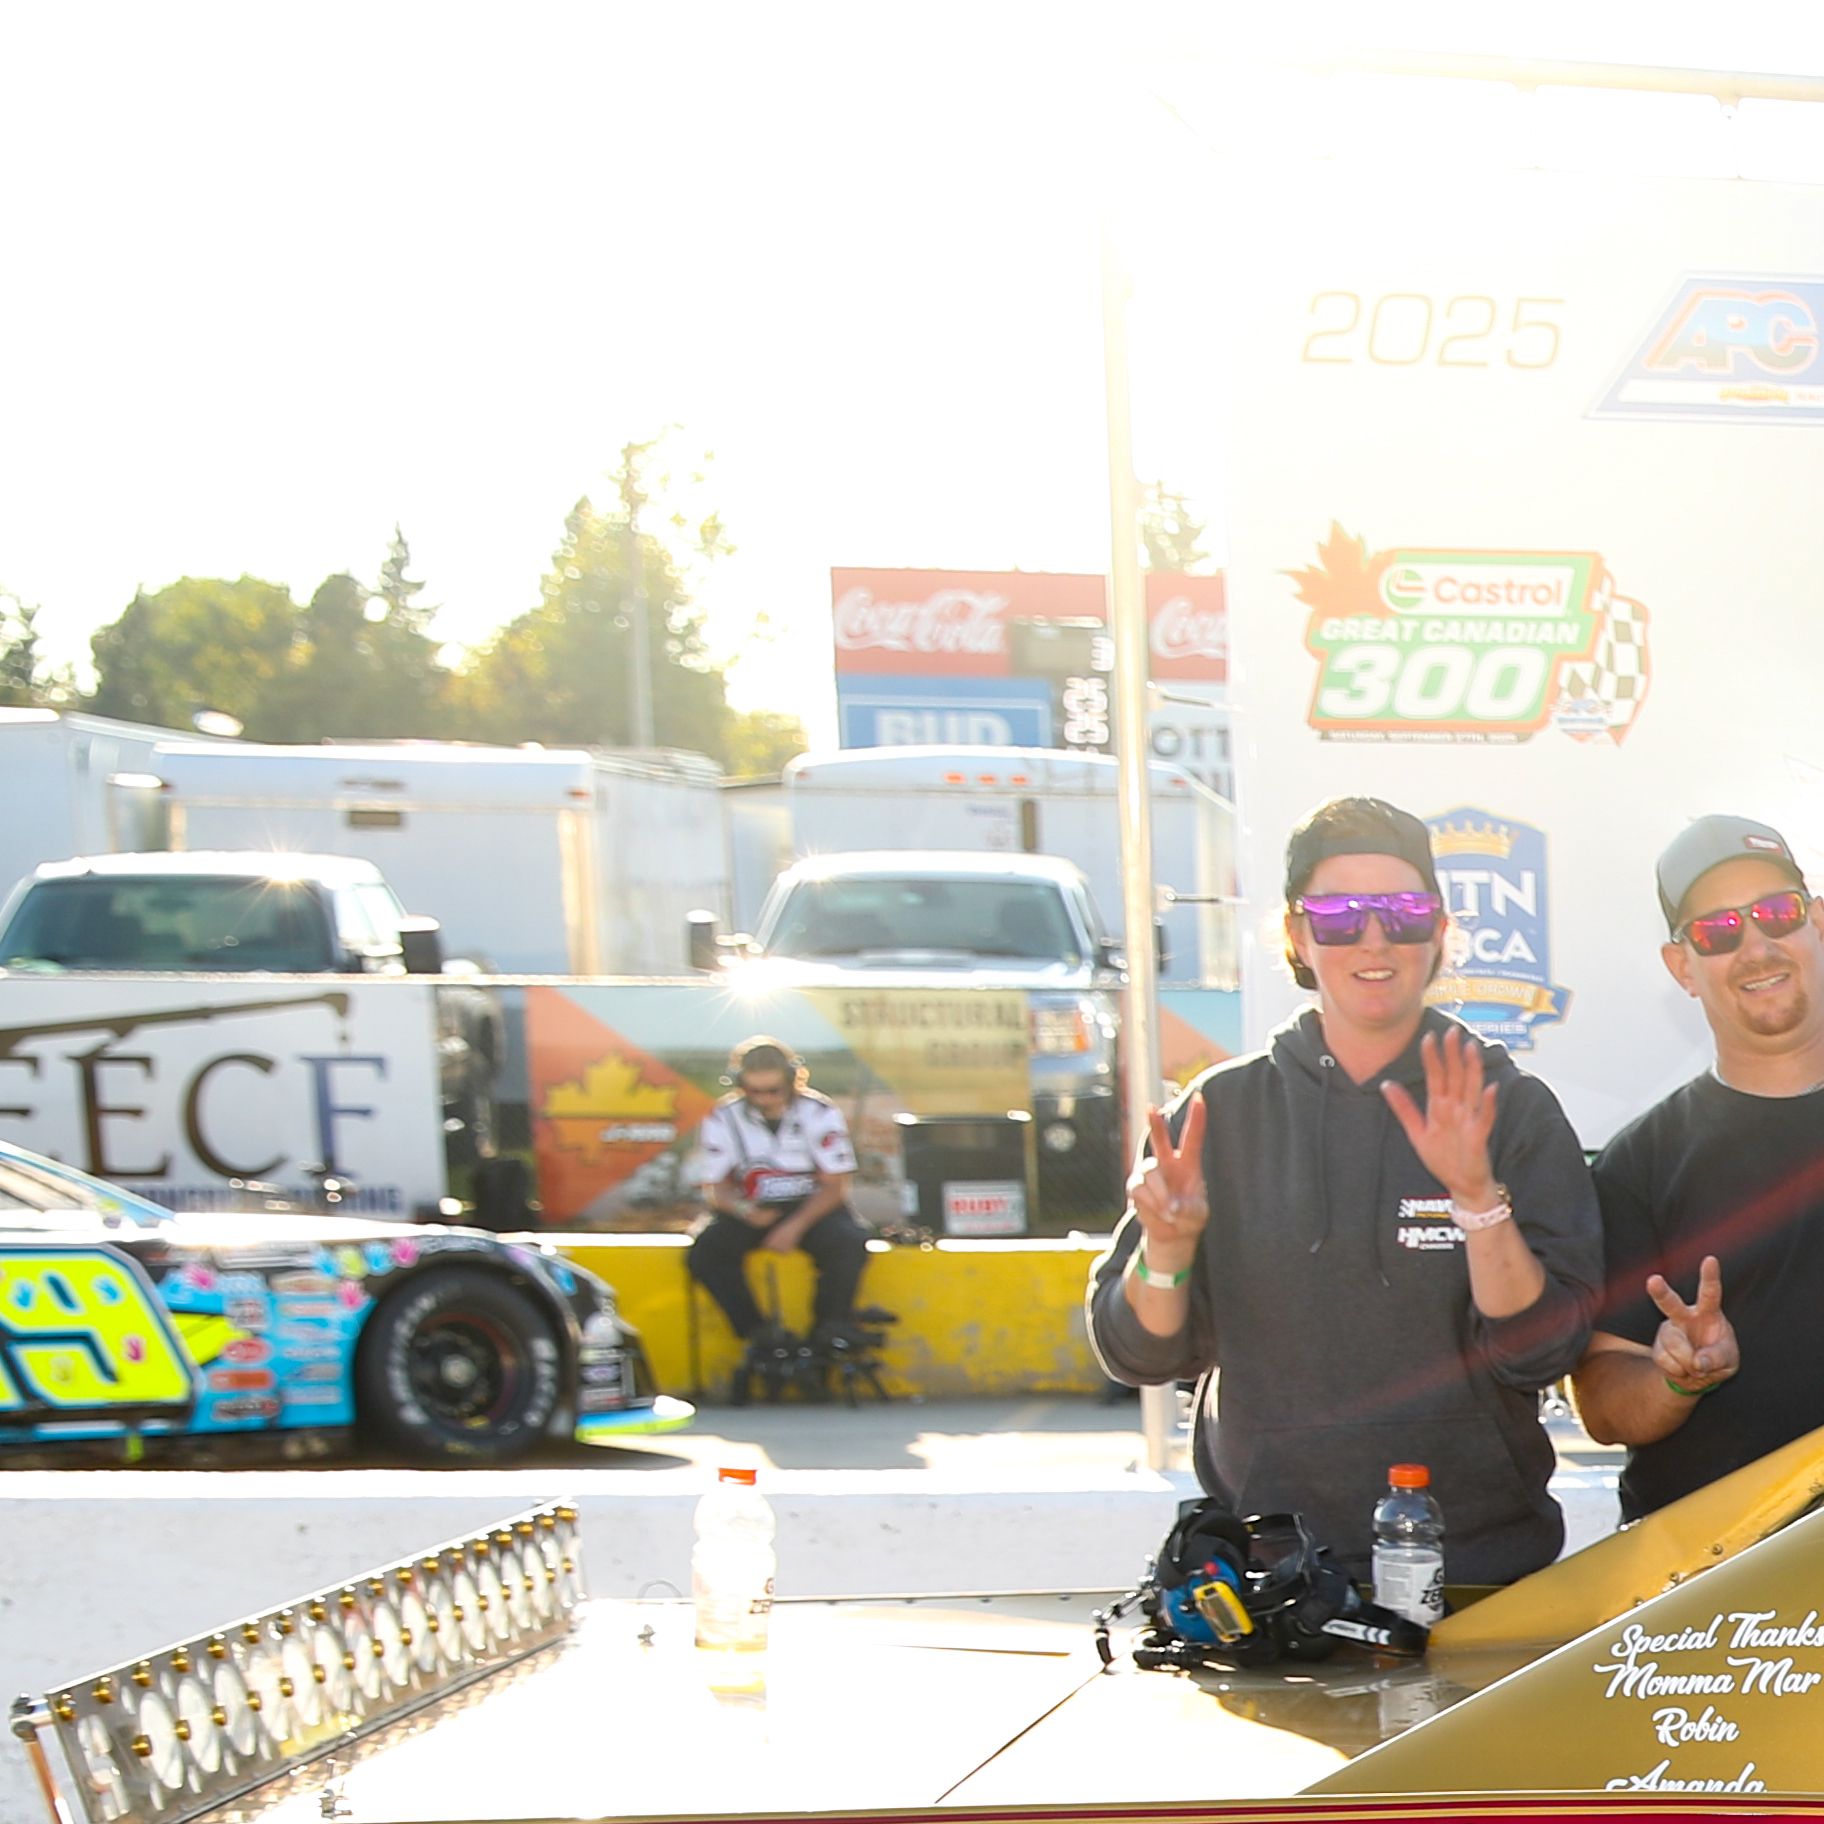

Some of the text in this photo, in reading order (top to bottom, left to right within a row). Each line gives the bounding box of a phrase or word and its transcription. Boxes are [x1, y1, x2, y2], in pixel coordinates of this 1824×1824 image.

[1300, 289, 1567, 372] 2025
[1640, 288, 1818, 374] APC
[1434, 576, 1563, 607] Castrol
[834, 584, 1009, 655] Coca-Cola
[1320, 618, 1582, 645] GREAT CANADIAN
[1319, 645, 1548, 719] 300
[870, 708, 1012, 747] BUD
[842, 997, 1028, 1032] STRUCTURAL
[1611, 1614, 1724, 1662] Special
[1593, 1656, 1822, 1700] Momma Mar
[1651, 1705, 1740, 1747] Robin
